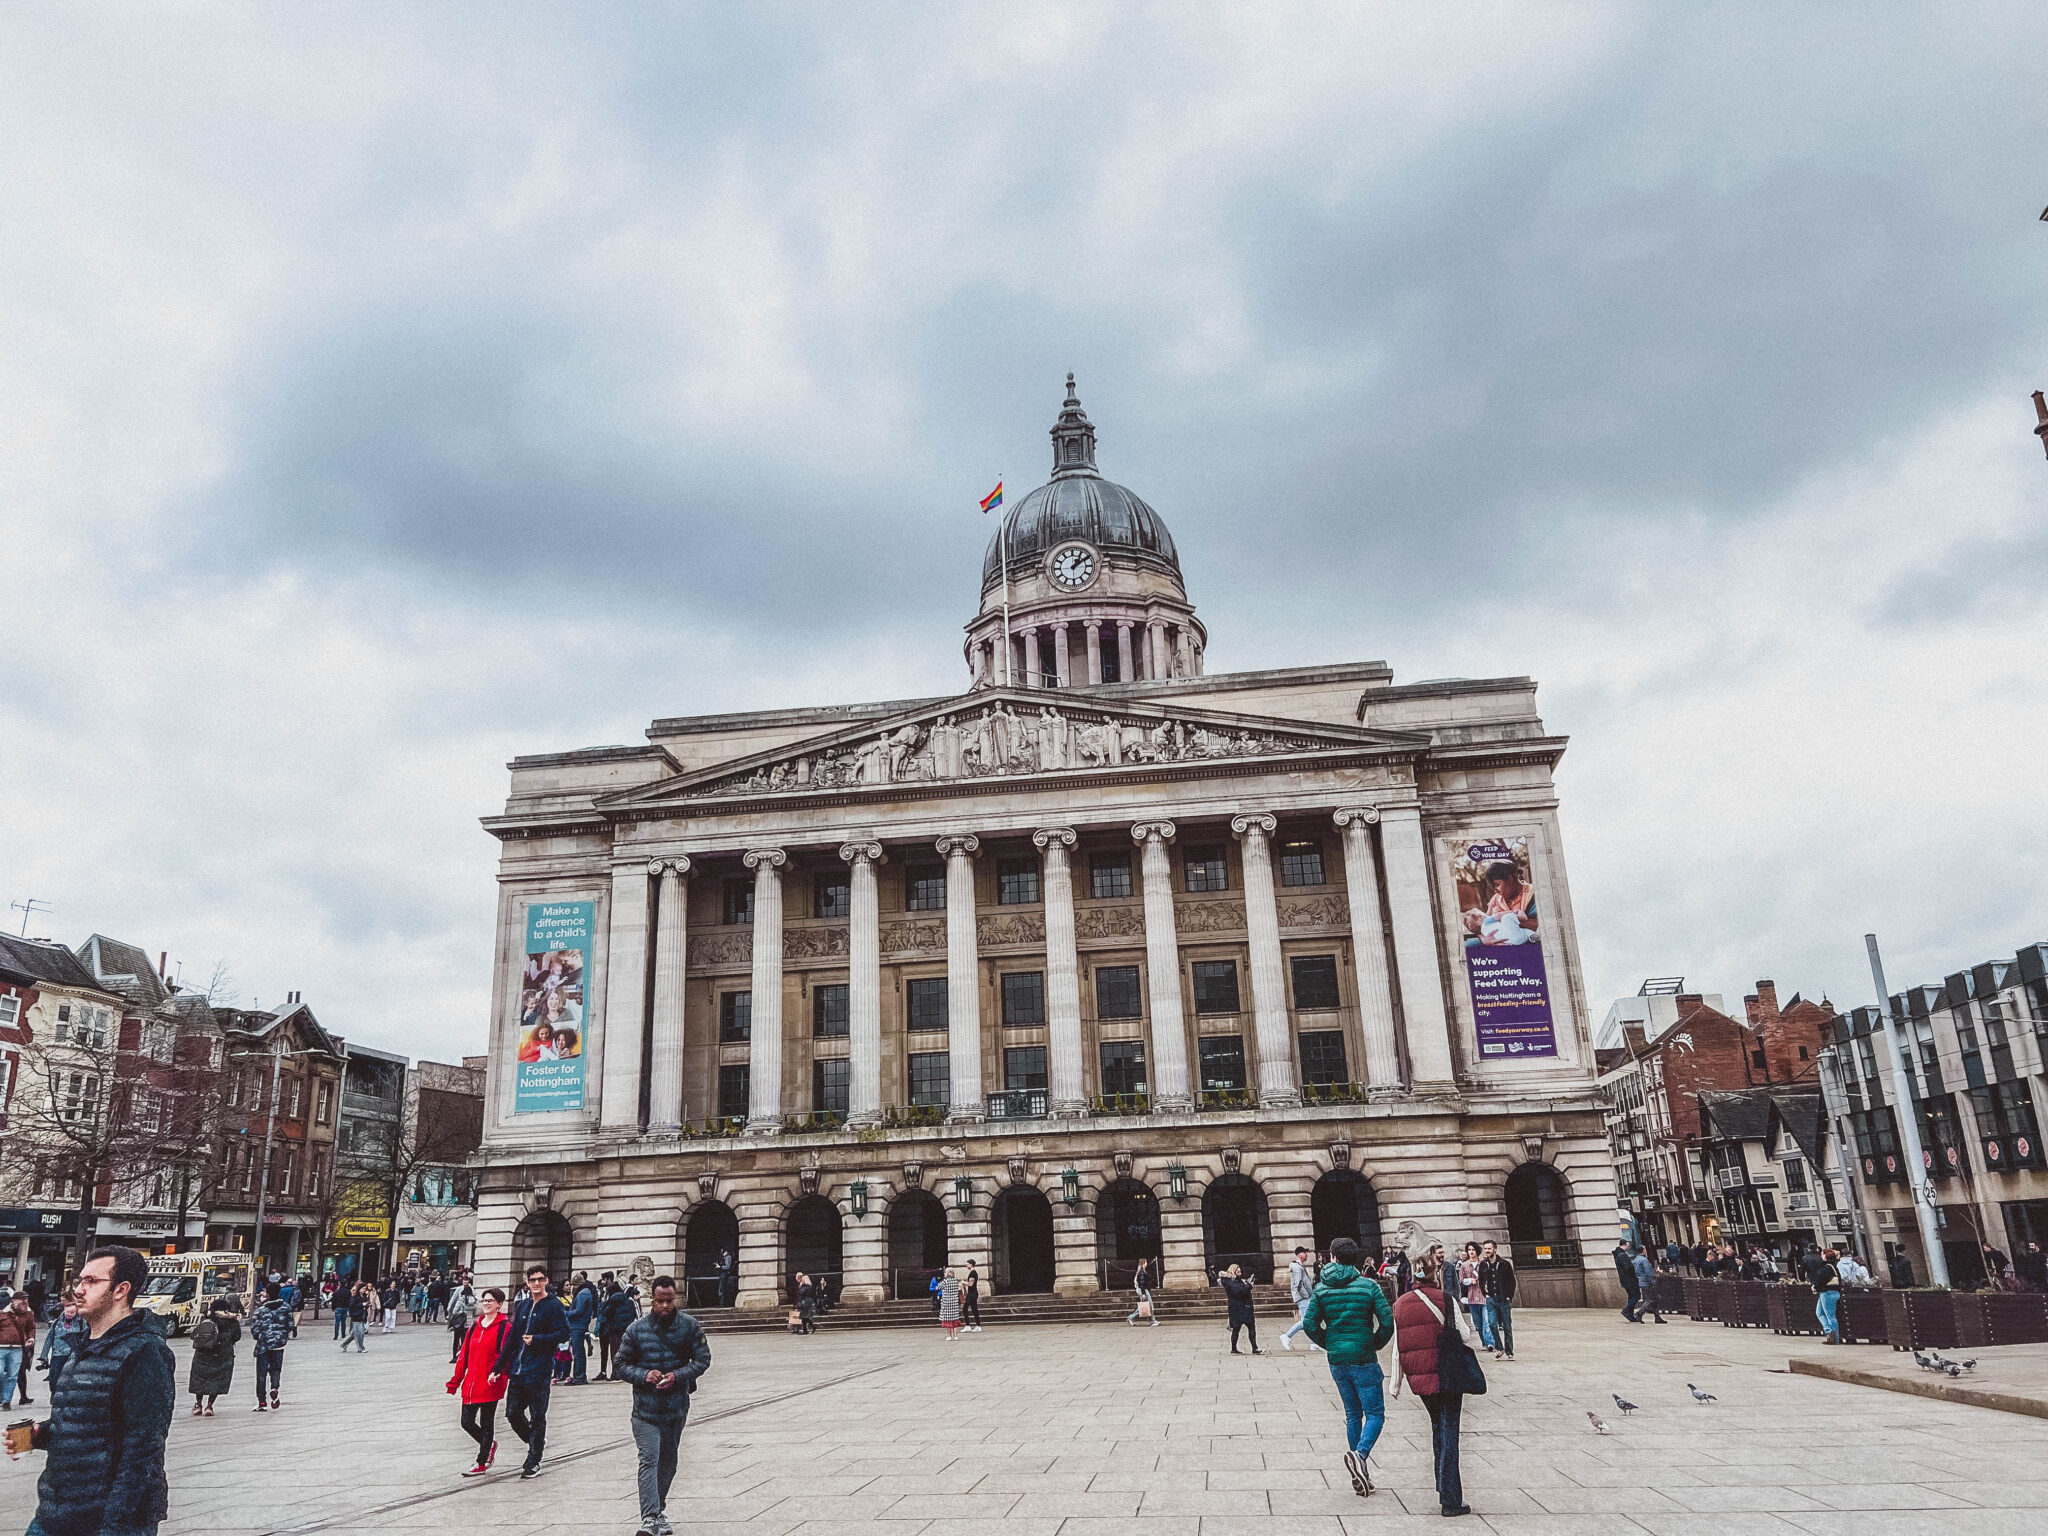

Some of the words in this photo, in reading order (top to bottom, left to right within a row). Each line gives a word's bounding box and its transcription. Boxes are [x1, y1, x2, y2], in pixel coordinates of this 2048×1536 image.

[543, 907, 571, 916] Make
[572, 907, 580, 915] a
[535, 917, 586, 928] difference
[533, 930, 544, 939] to
[546, 931, 553, 939] a
[554, 927, 587, 938] child's
[550, 940, 568, 949] life.
[1471, 957, 1498, 966] We're
[1473, 967, 1522, 978] supporting
[1474, 978, 1497, 988] Feed
[1497, 978, 1518, 987] Your
[1519, 977, 1543, 987] Way.
[1500, 992, 1536, 1000] Nottingham
[1477, 999, 1546, 1008] breastfeeding-friendly
[526, 1065, 560, 1076] Foster
[561, 1064, 577, 1074] for
[520, 1076, 580, 1088] Nottingham
[1925, 1186, 1936, 1199] 25
[41, 1214, 62, 1225] RUSH
[150, 1260, 160, 1268] Ice
